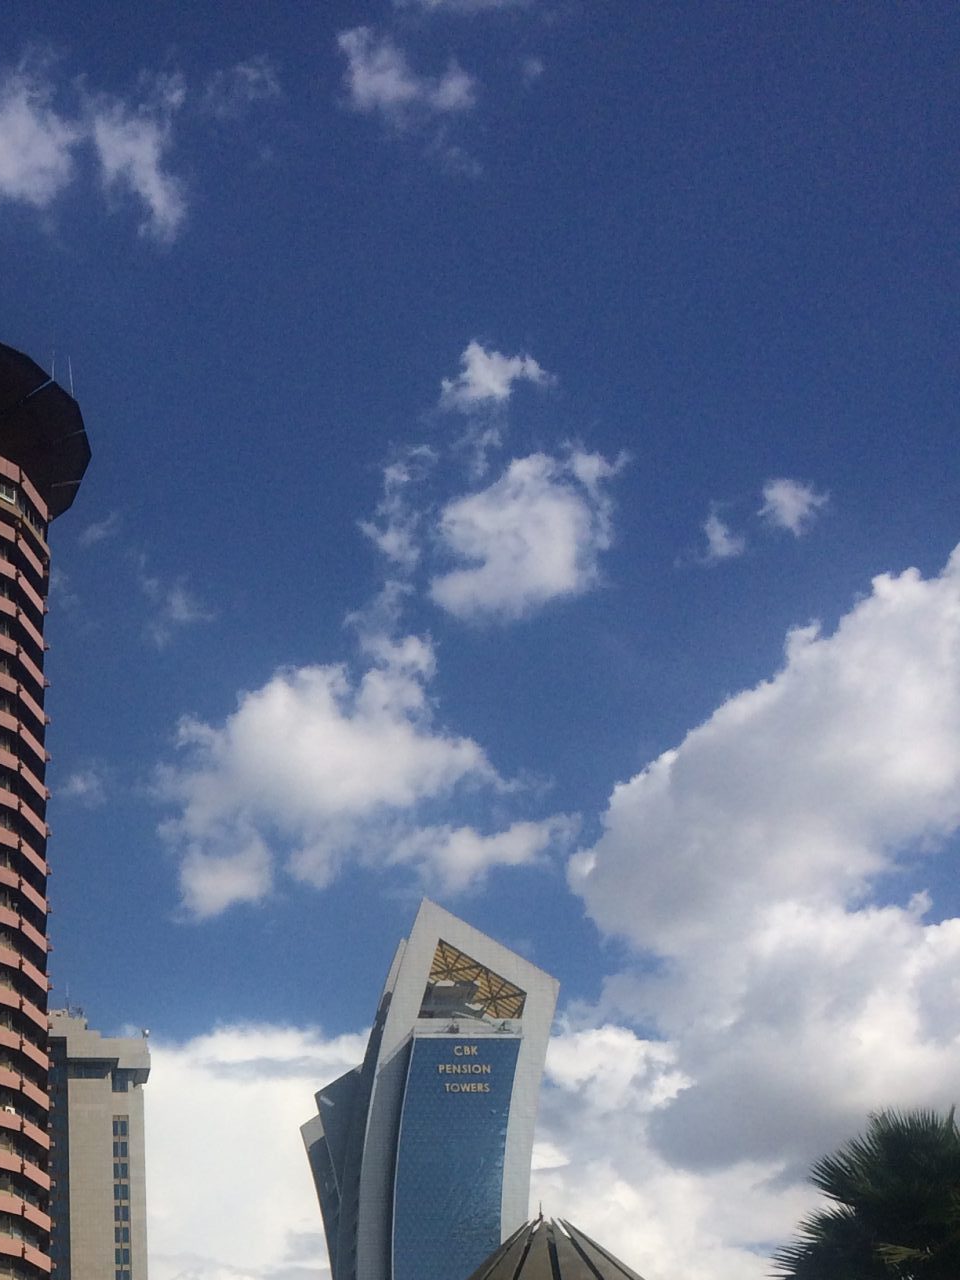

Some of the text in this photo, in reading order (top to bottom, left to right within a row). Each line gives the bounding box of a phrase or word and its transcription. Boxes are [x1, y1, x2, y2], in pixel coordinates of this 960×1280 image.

[453, 1045, 478, 1056] CBK
[438, 1064, 491, 1074] PENSION
[445, 1083, 490, 1093] TOWERS
